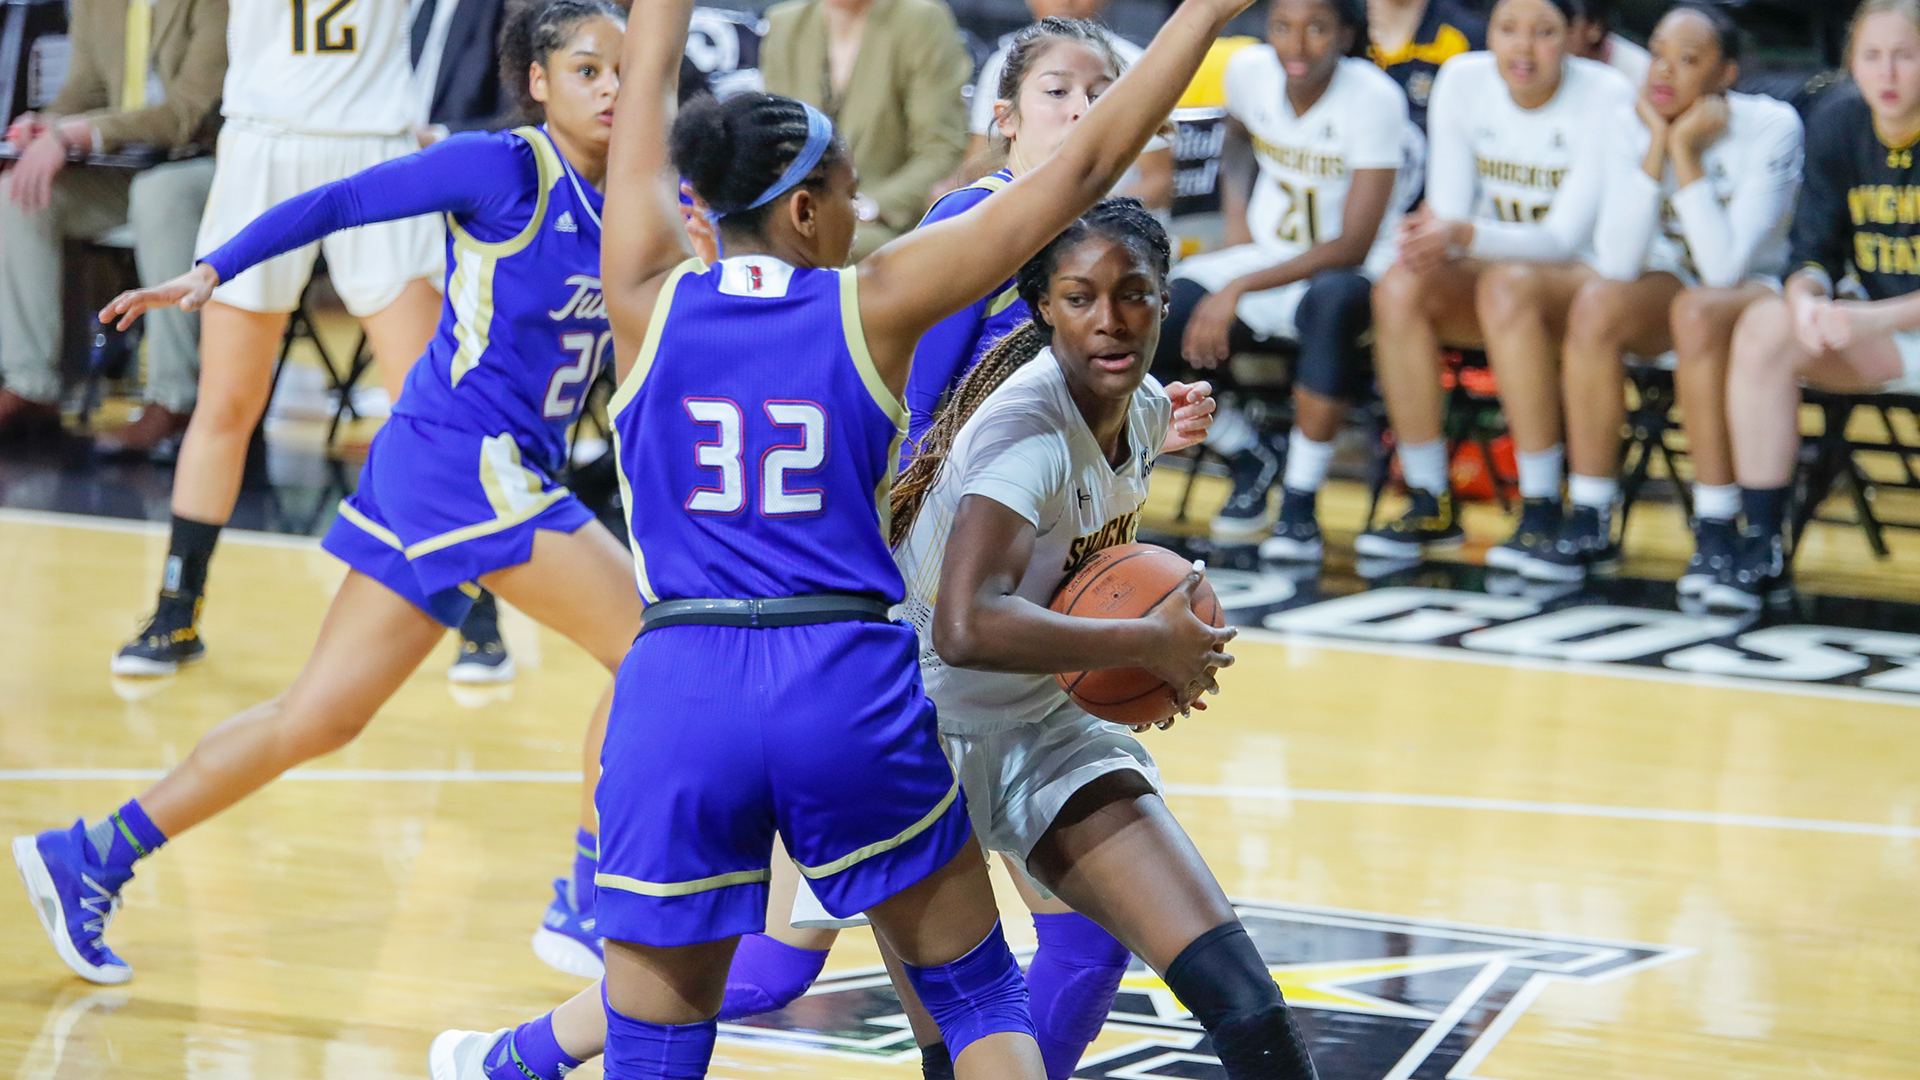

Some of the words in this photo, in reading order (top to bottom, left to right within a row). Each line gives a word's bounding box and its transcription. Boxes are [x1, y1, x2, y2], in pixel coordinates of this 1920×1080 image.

[291, 0, 357, 53] 12
[1847, 184, 1920, 225] WICH
[683, 397, 828, 518] 32
